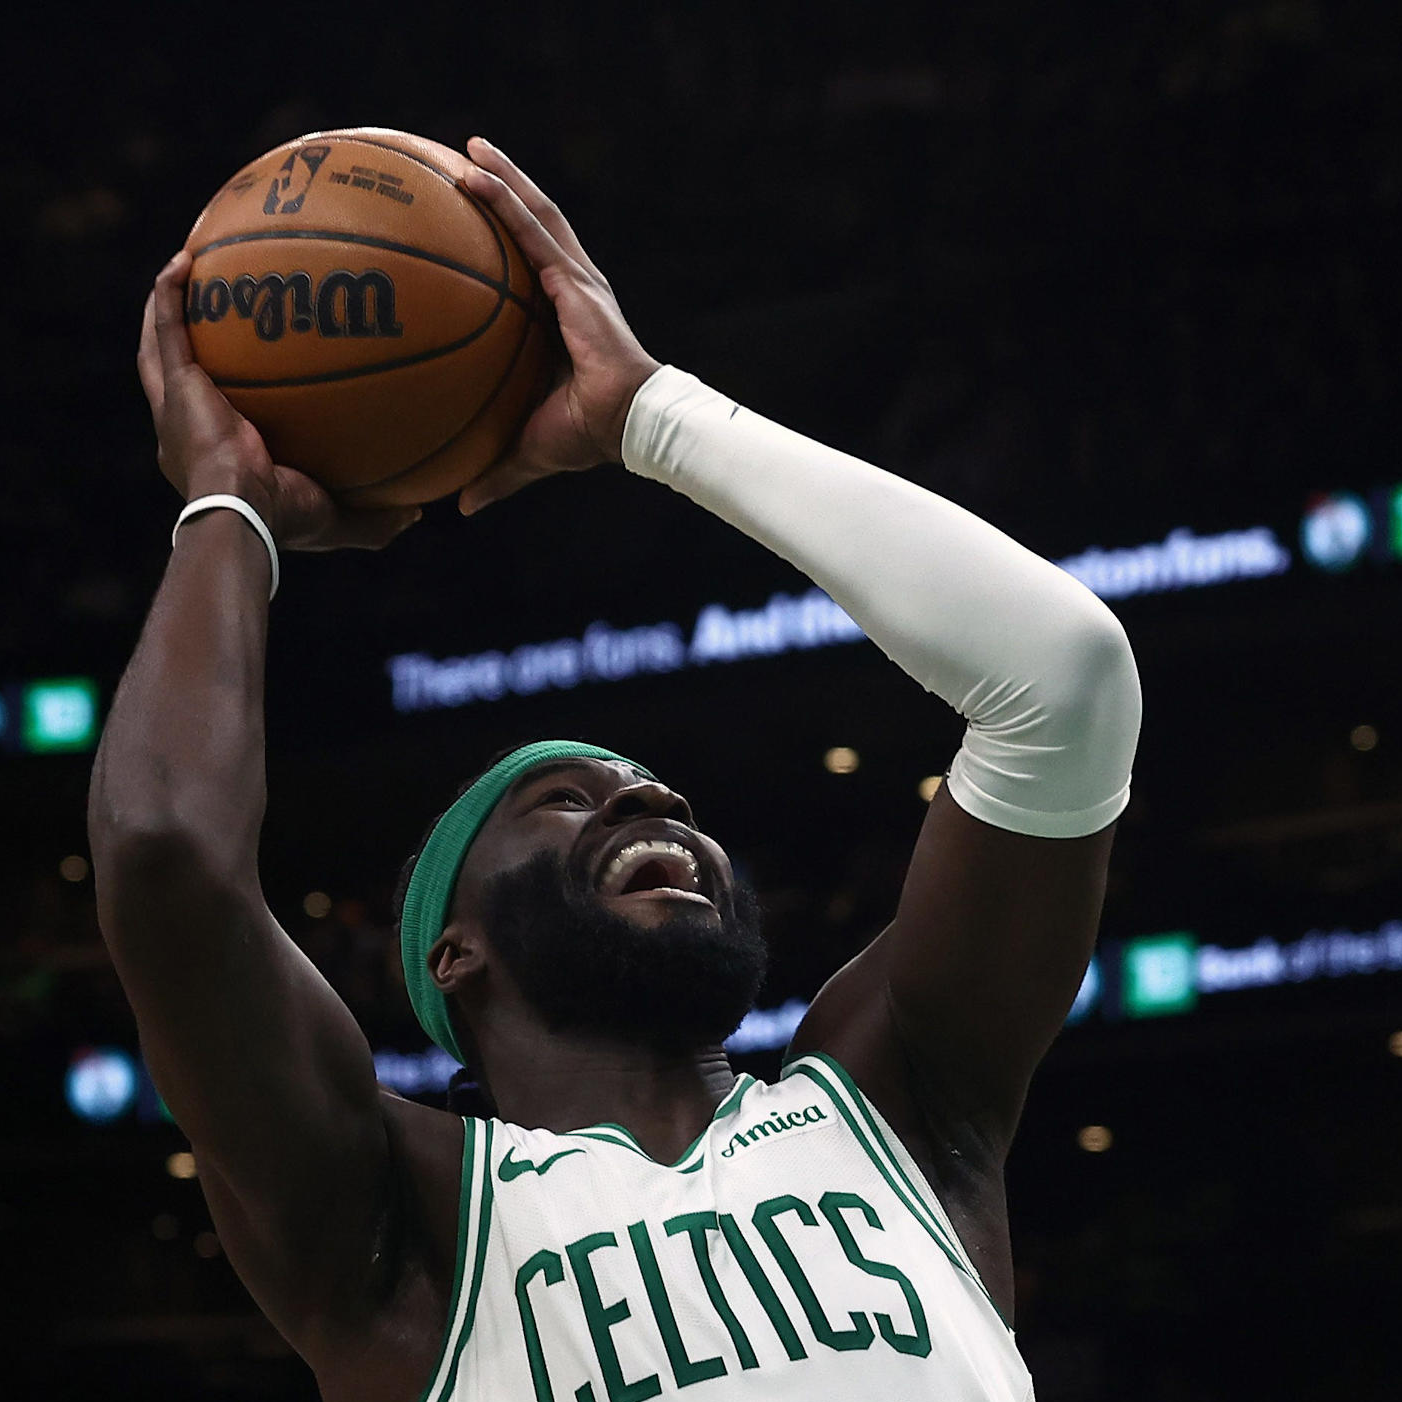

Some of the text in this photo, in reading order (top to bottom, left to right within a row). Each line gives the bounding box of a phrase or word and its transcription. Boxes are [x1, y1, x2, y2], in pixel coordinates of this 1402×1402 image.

[389, 652, 501, 710] There
[503, 640, 580, 694] are
[689, 604, 784, 663] And
[721, 1102, 828, 1158] Amica
